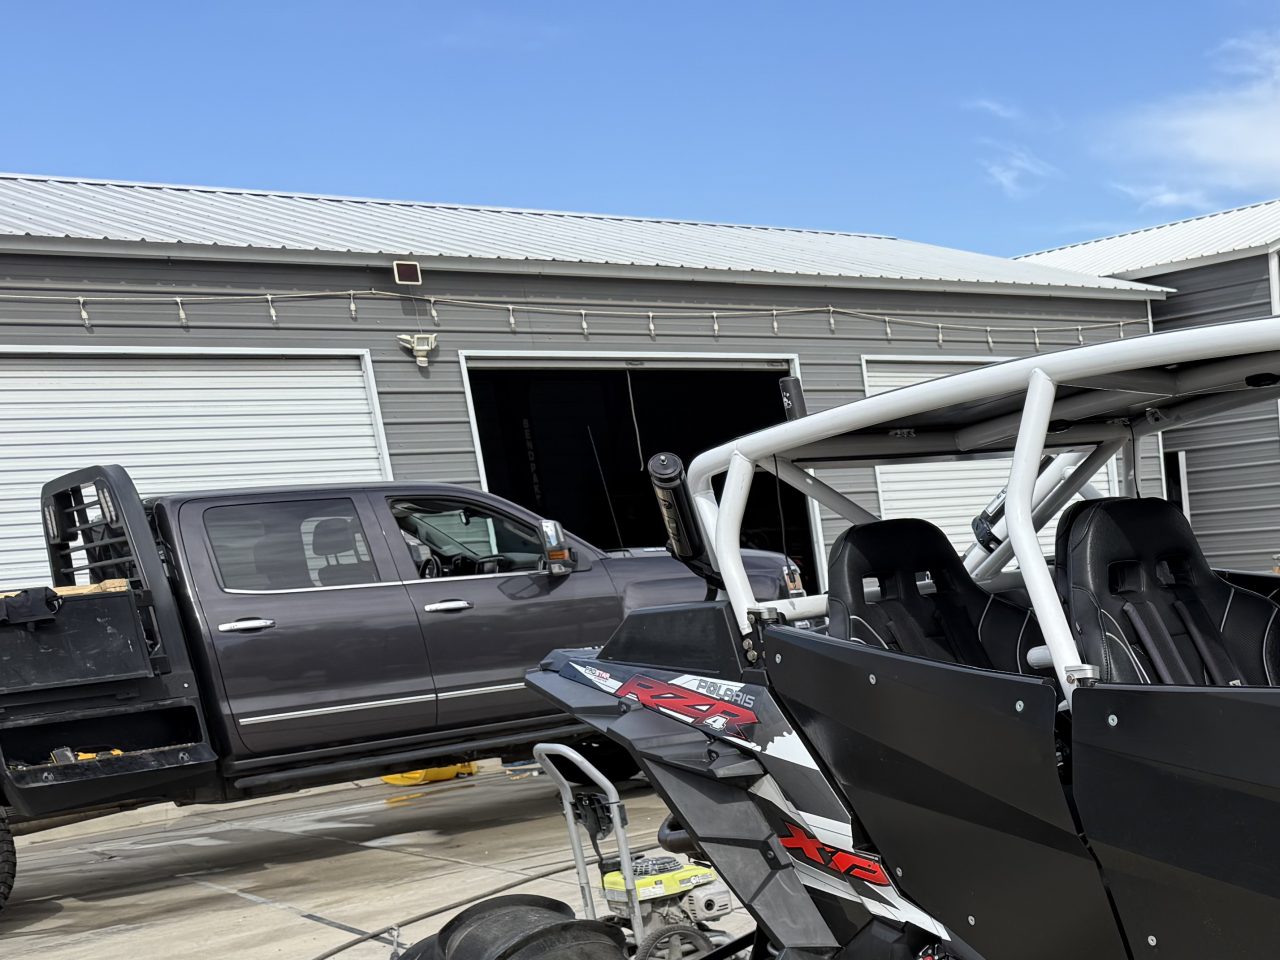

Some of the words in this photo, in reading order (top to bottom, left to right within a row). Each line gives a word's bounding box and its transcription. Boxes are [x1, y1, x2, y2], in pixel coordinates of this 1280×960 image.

[614, 673, 761, 740] RZR
[695, 678, 756, 709] POLARIS
[703, 713, 730, 731] 4
[779, 821, 891, 887] XP
